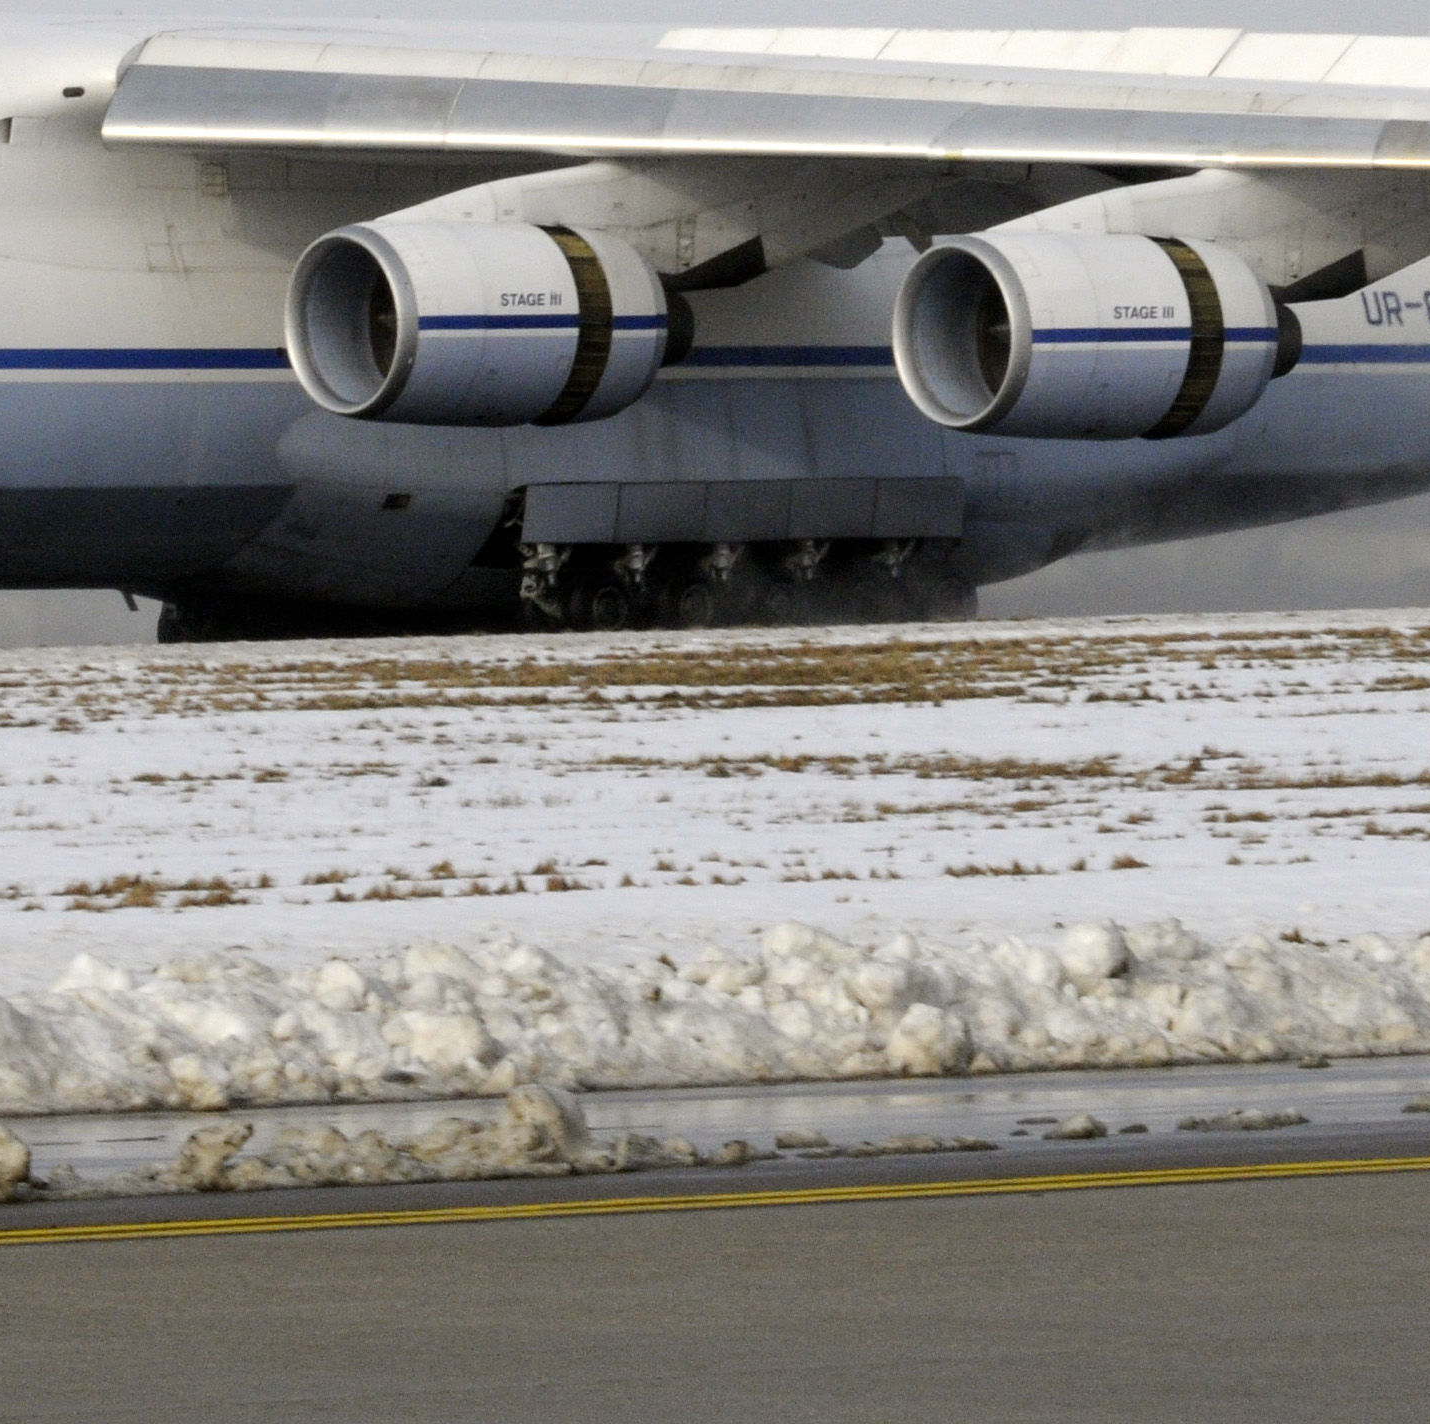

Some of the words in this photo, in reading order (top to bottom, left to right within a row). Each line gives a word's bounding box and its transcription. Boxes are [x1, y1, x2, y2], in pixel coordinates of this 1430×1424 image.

[500, 292, 546, 307] STAGE
[1113, 306, 1159, 320] STAGE
[1162, 306, 1175, 319] III
